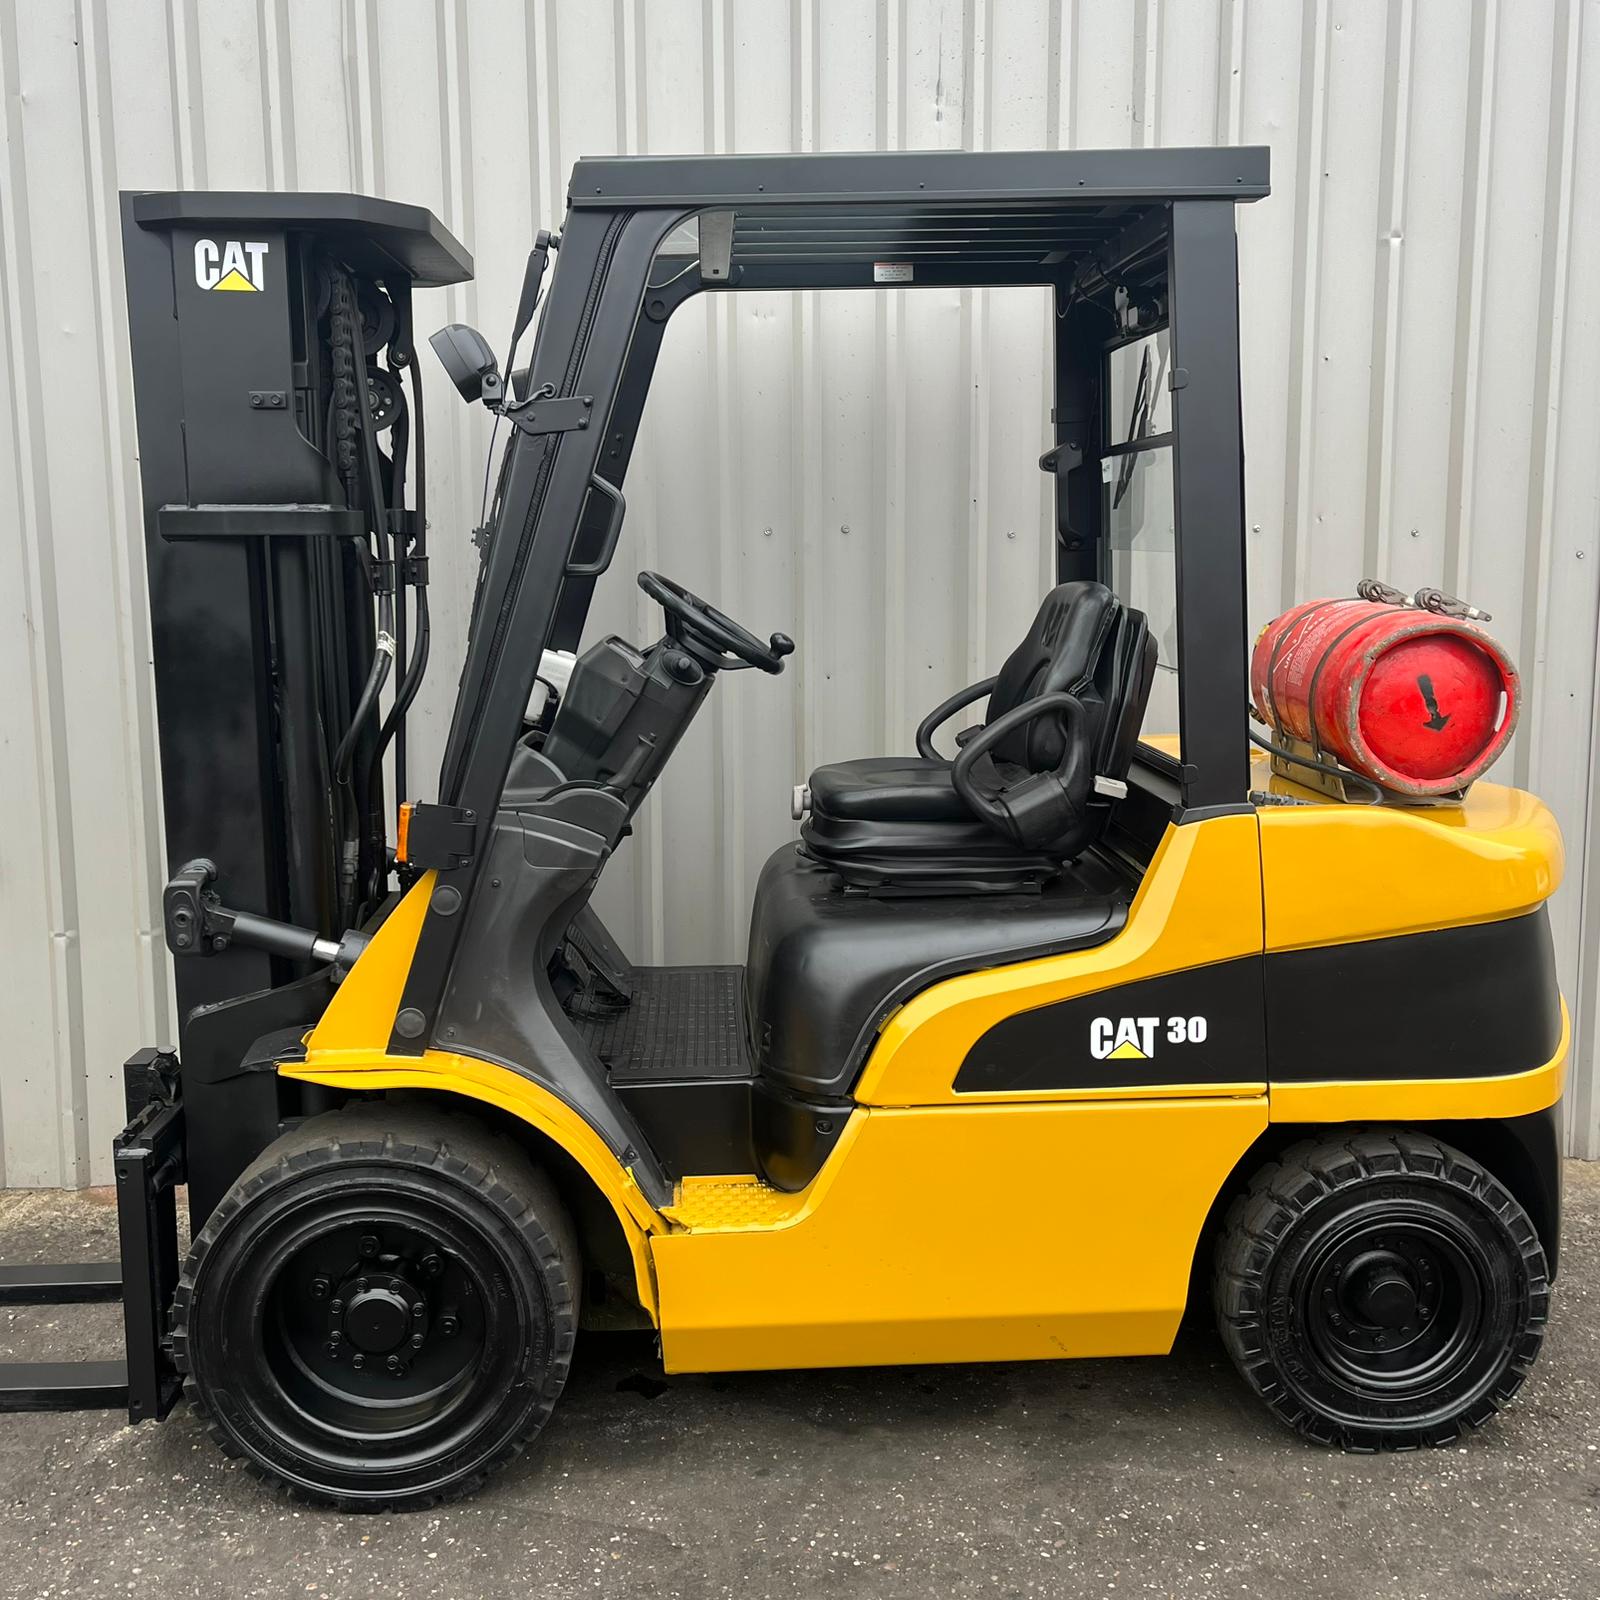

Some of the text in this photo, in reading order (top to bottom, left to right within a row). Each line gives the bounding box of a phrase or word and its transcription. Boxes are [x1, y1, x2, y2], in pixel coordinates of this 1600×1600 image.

[194, 239, 269, 292] CAT
[1090, 1016, 1207, 1060] CAT 30
